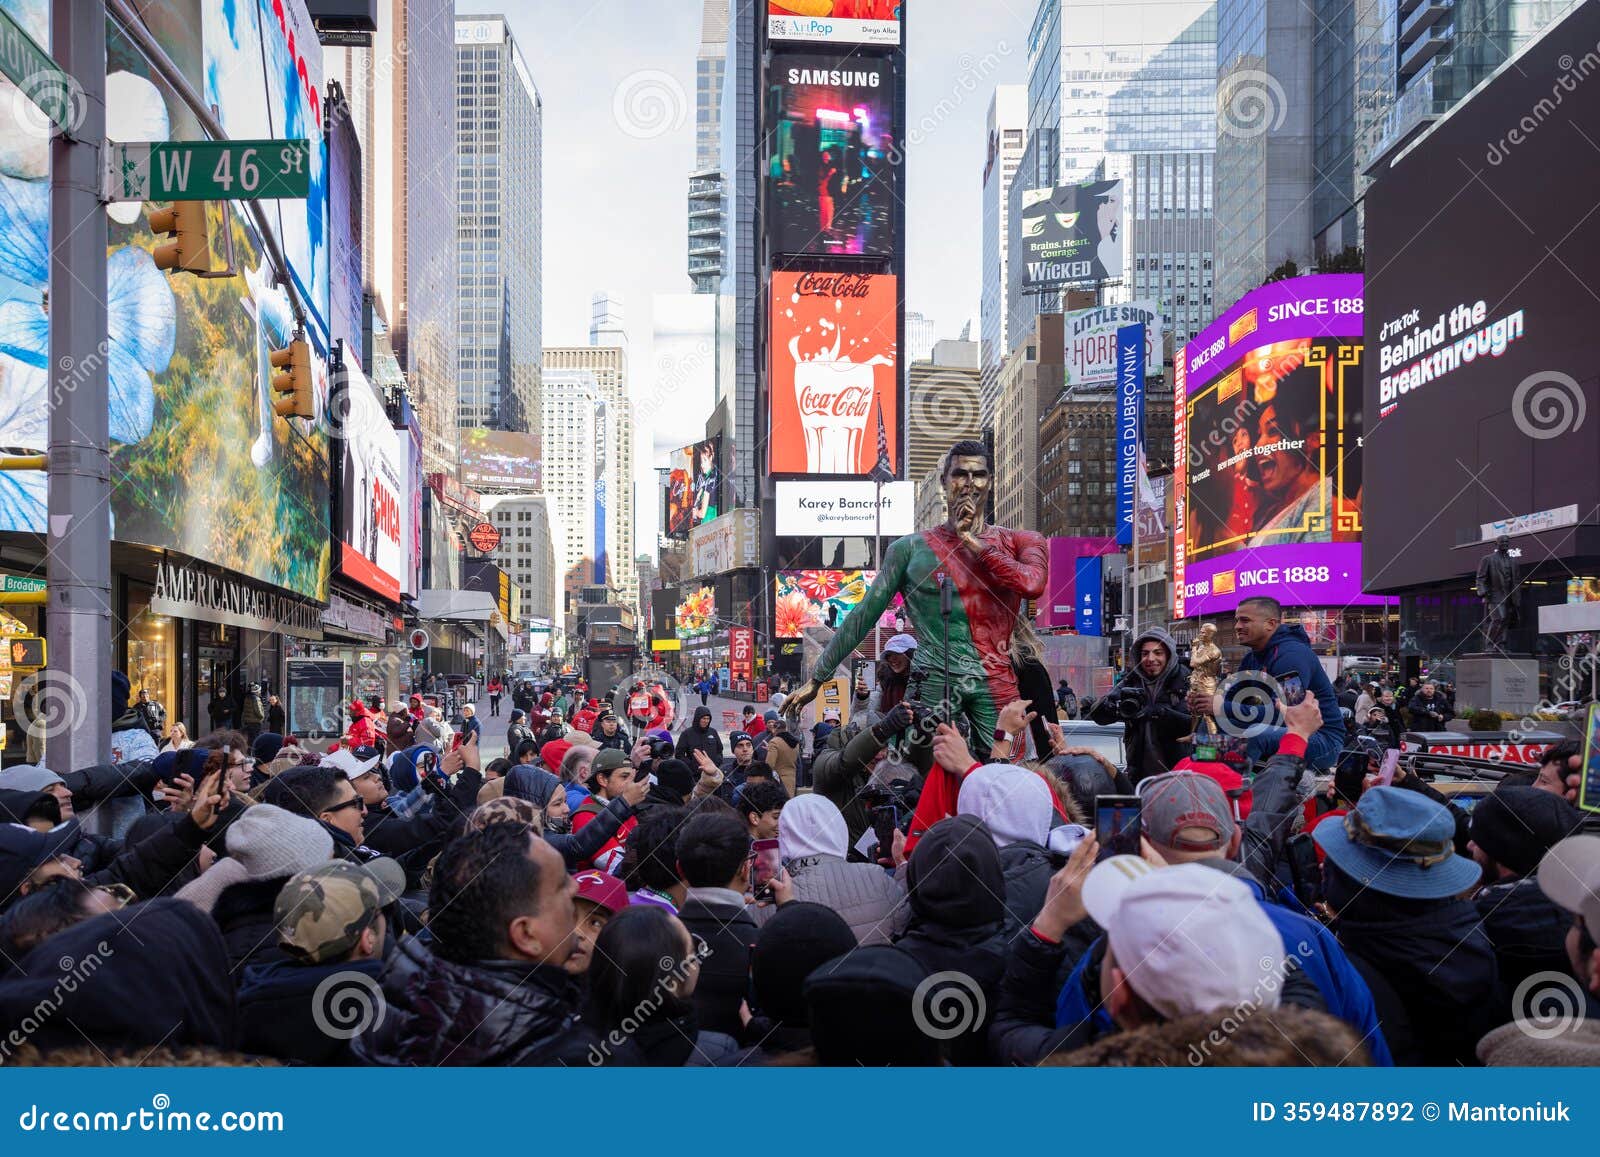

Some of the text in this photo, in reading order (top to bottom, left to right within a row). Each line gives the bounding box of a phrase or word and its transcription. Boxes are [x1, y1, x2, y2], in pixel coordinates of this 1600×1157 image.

[788, 69, 880, 87] SAMSUNG
[159, 148, 303, 192] W 46 St
[1031, 239, 1090, 251] Brains. Heart.
[1041, 248, 1079, 258] Courage.
[796, 271, 872, 297] Coca-Cola
[1073, 306, 1154, 336] LITTLE SHOP
[1268, 298, 1364, 322] SINCE 188
[1389, 309, 1420, 337] TikTok
[1380, 300, 1487, 373] Behind the
[1191, 336, 1226, 373] SINCE 1888
[800, 385, 871, 417] Coca-Cola
[1124, 344, 1137, 440] DUBROVNIK
[1253, 439, 1305, 456] together
[373, 475, 401, 548] CHICA
[799, 498, 834, 511] Karey
[7, 578, 46, 592] Broadwa
[154, 560, 239, 615] AMERICAN
[242, 585, 276, 621] EAGLE
[1240, 566, 1329, 587] SINCE 1888
[736, 629, 750, 659] tkts
